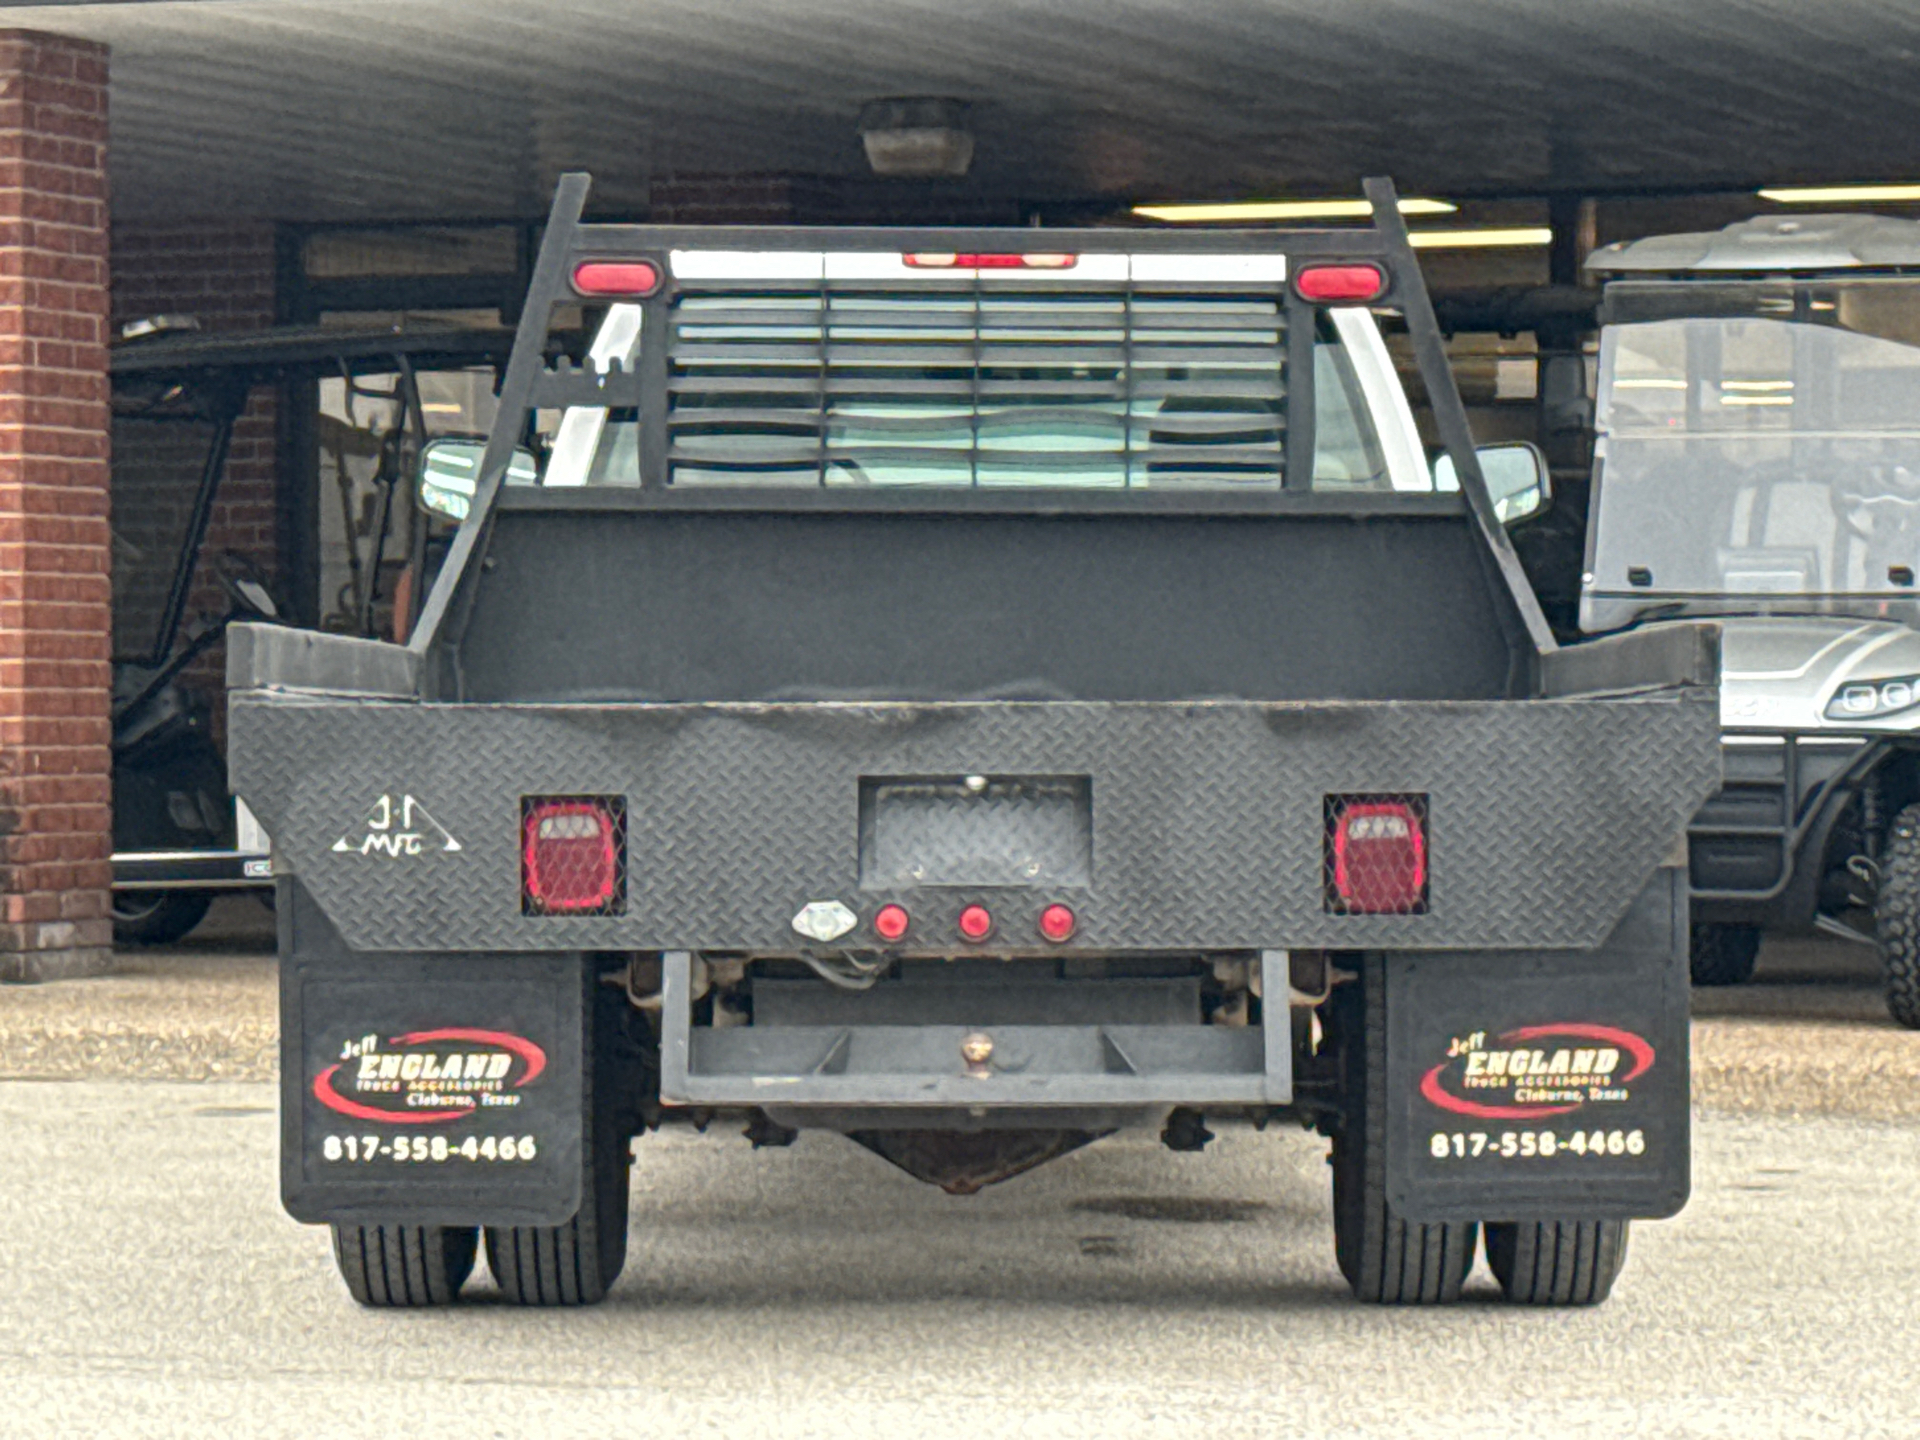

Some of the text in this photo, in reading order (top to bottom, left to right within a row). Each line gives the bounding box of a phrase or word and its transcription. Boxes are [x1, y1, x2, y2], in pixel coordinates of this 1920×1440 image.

[340, 1033, 378, 1060] Jeff
[1446, 1030, 1487, 1057] Jeff
[357, 1053, 513, 1080] ENGLAND
[1465, 1048, 1620, 1076] ENGLAND
[356, 1080, 504, 1092] TRUCK ACCESSORIES
[1463, 1075, 1612, 1088] TRUCK ACCESSORIES
[1589, 1087, 1629, 1101] Texas
[481, 1092, 521, 1106] Texas
[323, 1134, 537, 1161] 817-558-4466
[1430, 1129, 1645, 1158] 817-558-4466
